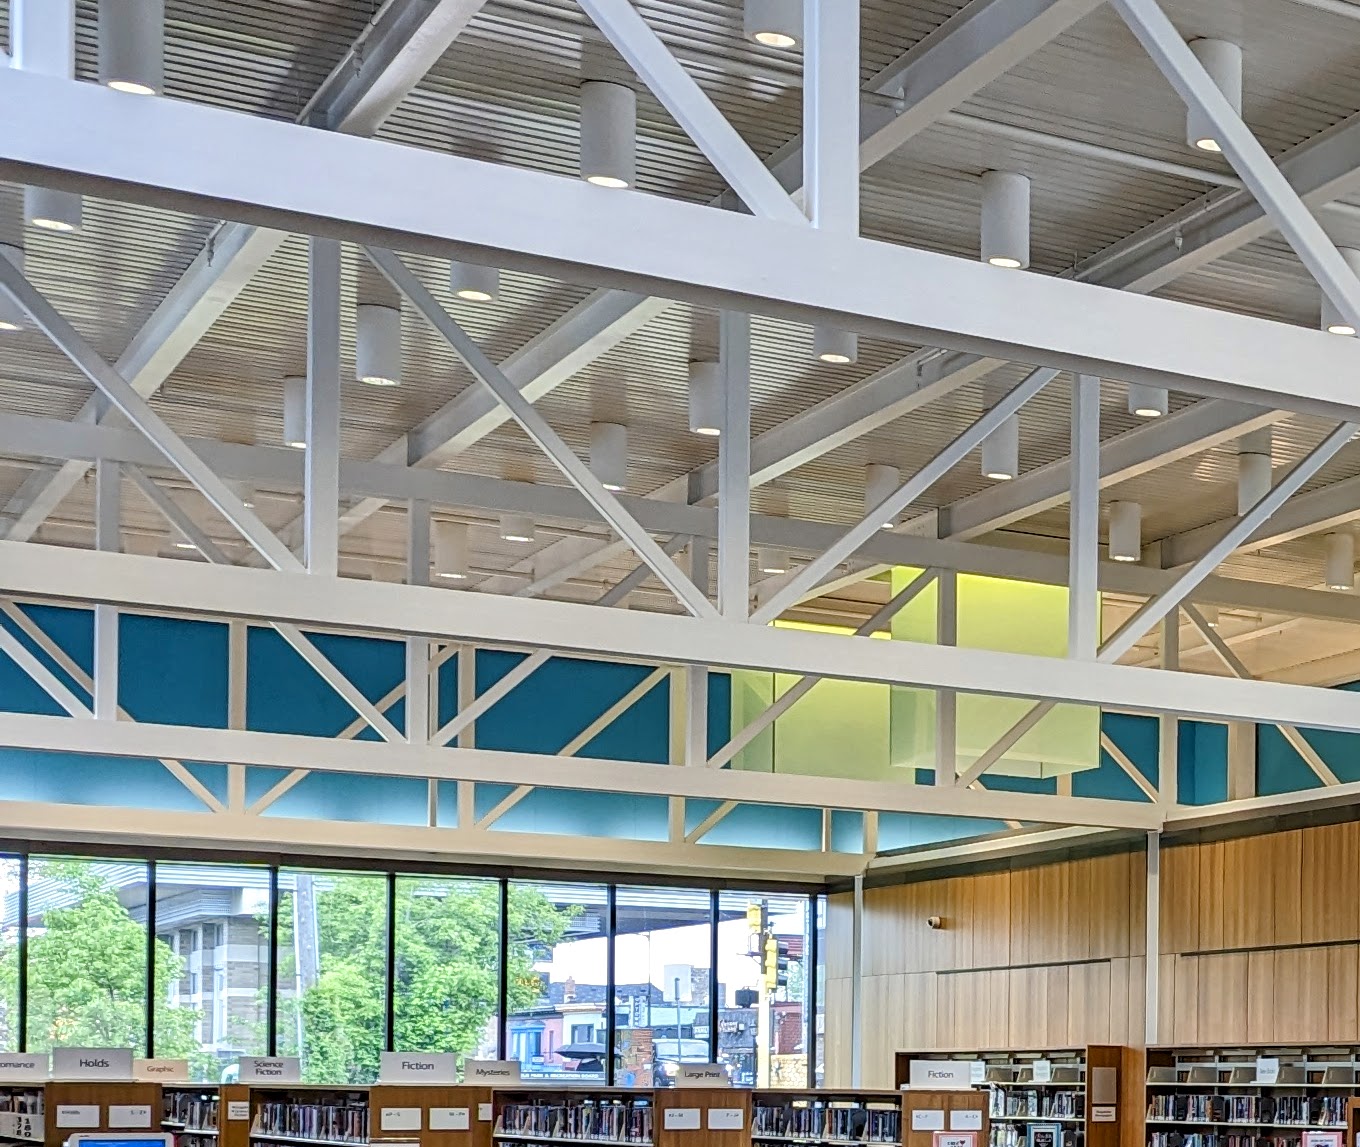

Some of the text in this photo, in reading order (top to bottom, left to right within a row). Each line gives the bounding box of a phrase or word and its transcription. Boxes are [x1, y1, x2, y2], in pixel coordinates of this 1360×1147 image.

[79, 1058, 110, 1069] Holds
[253, 1060, 284, 1069] Science
[401, 1061, 435, 1071] Fiction
[146, 1065, 175, 1075] Graphic
[254, 1068, 283, 1077] Fiction
[475, 1068, 511, 1077] Mysteries
[927, 1070, 954, 1079] Fiction
[684, 1071, 721, 1080] Large Print
